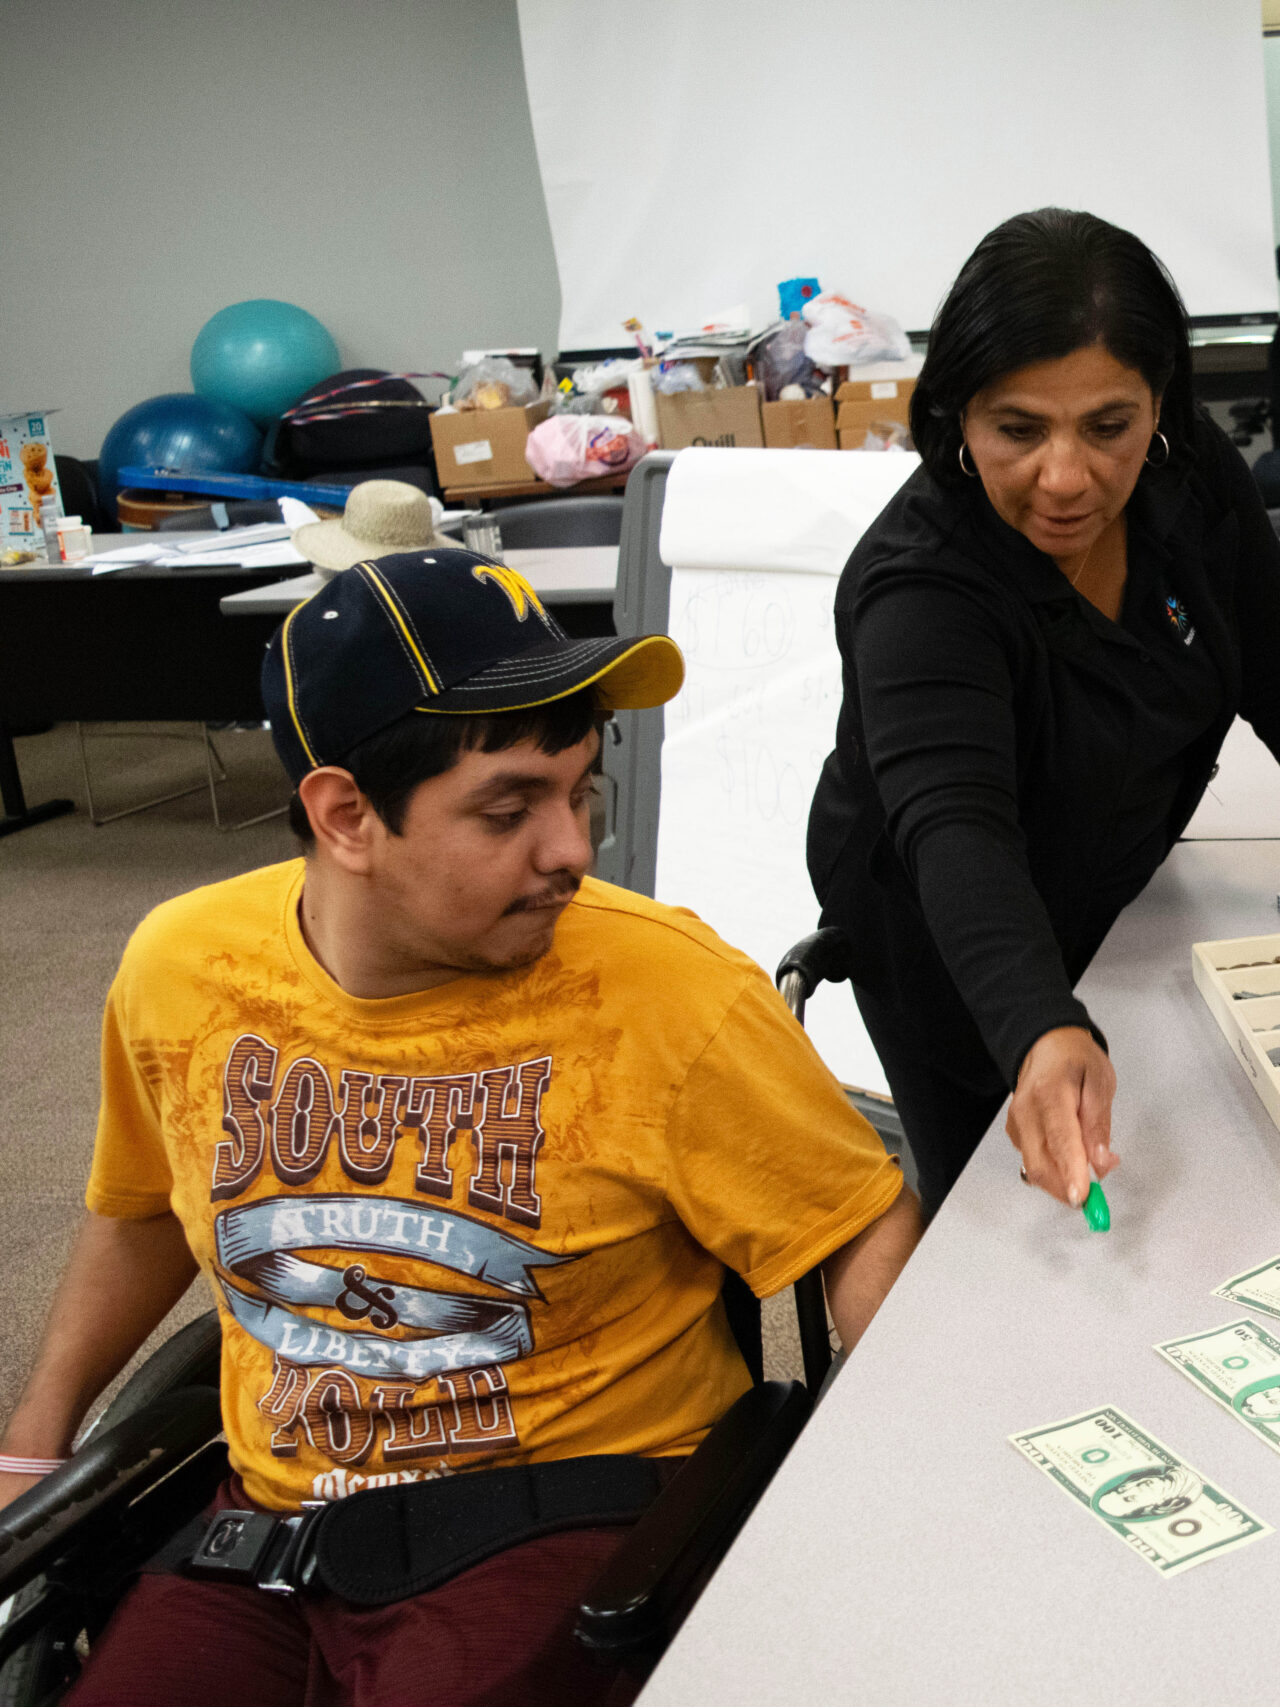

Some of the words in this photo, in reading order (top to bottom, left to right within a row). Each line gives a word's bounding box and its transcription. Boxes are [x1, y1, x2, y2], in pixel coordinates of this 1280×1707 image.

[210, 1033, 553, 1229] SOUTH
[276, 1205, 455, 1254] TRUTH
[334, 1263, 400, 1330] &
[1230, 1328, 1254, 1341] 50
[1094, 1419, 1123, 1439] 100
[1015, 1438, 1051, 1466] 100
[1215, 1502, 1253, 1531] 100
[1126, 1534, 1165, 1564] 100
